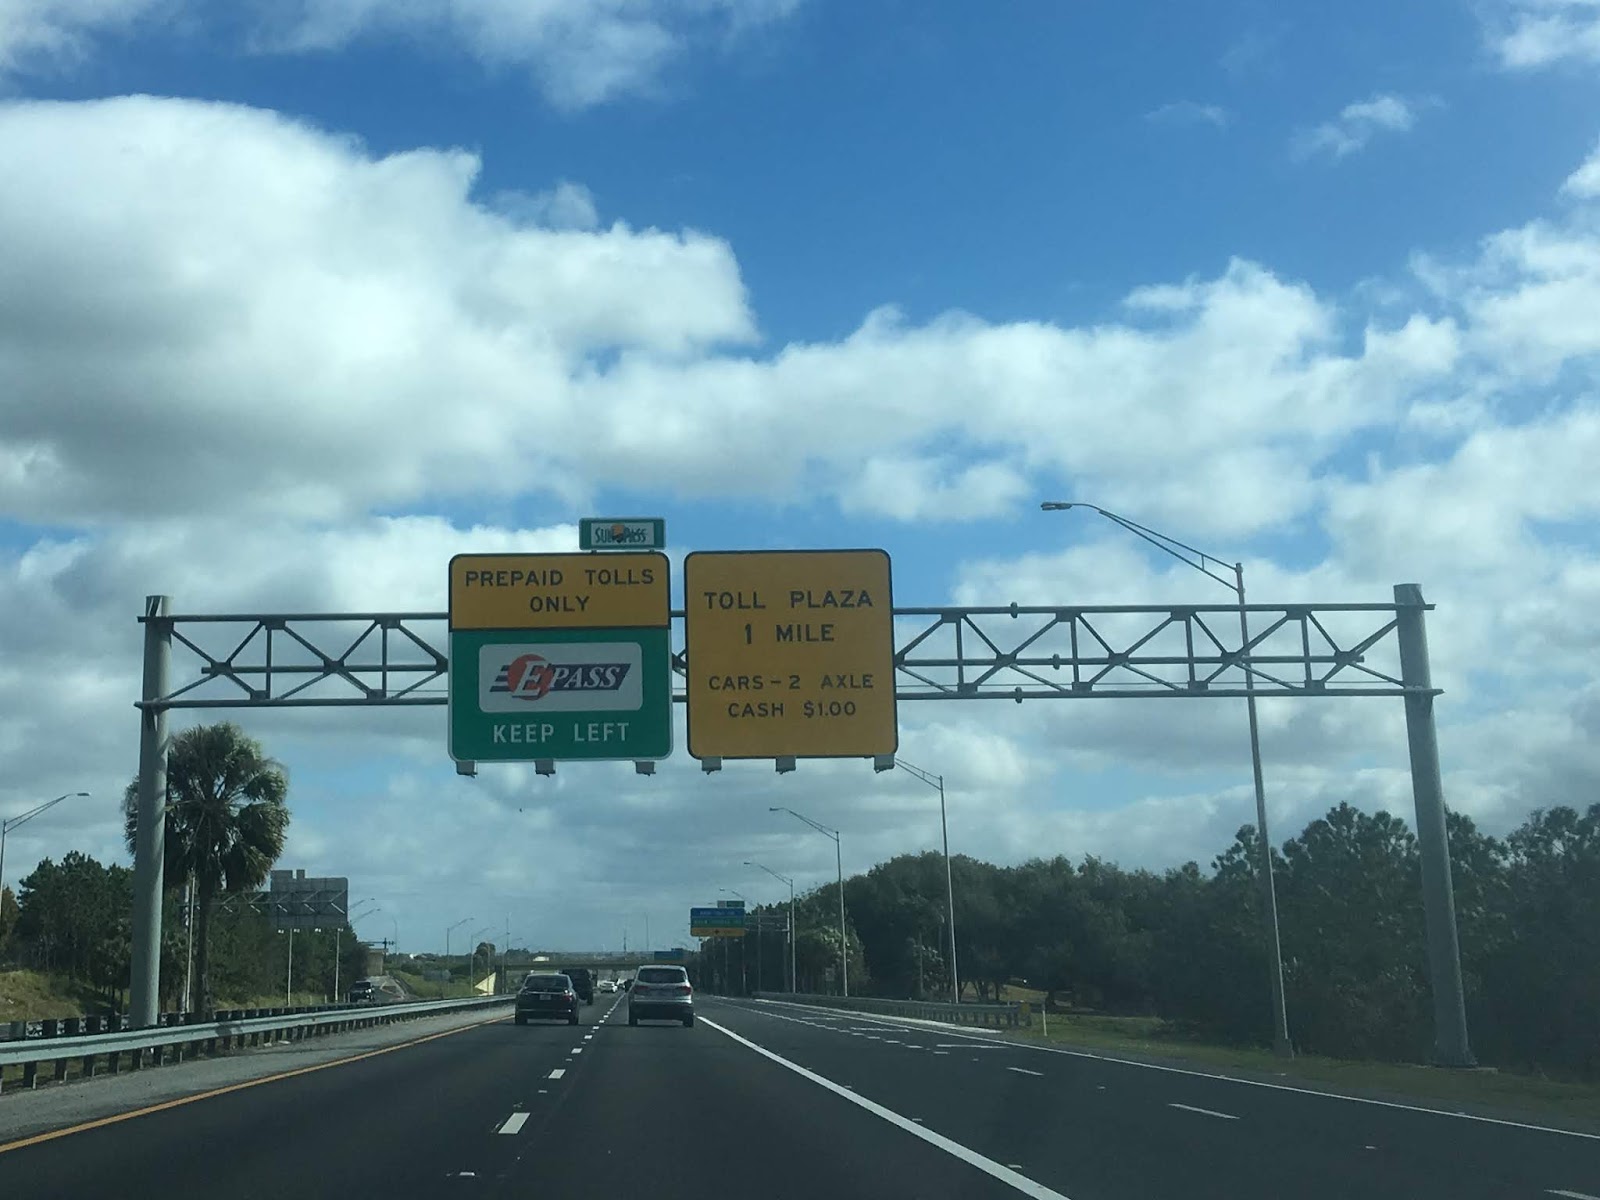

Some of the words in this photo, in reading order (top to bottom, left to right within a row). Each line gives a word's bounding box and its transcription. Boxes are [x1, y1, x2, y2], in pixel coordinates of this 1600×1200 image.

[465, 570, 563, 587] PREPAID
[585, 569, 654, 586] TOLLS
[530, 596, 590, 612] ONLY
[704, 591, 766, 609] TOLL
[790, 590, 873, 608] PLAZA
[745, 624, 752, 644] 1
[776, 624, 834, 642] MILE
[820, 674, 873, 689] AXLE
[728, 702, 784, 718] CASH
[803, 701, 856, 718] $1.00
[493, 724, 555, 743] KEEP
[574, 722, 629, 742] LEFT
